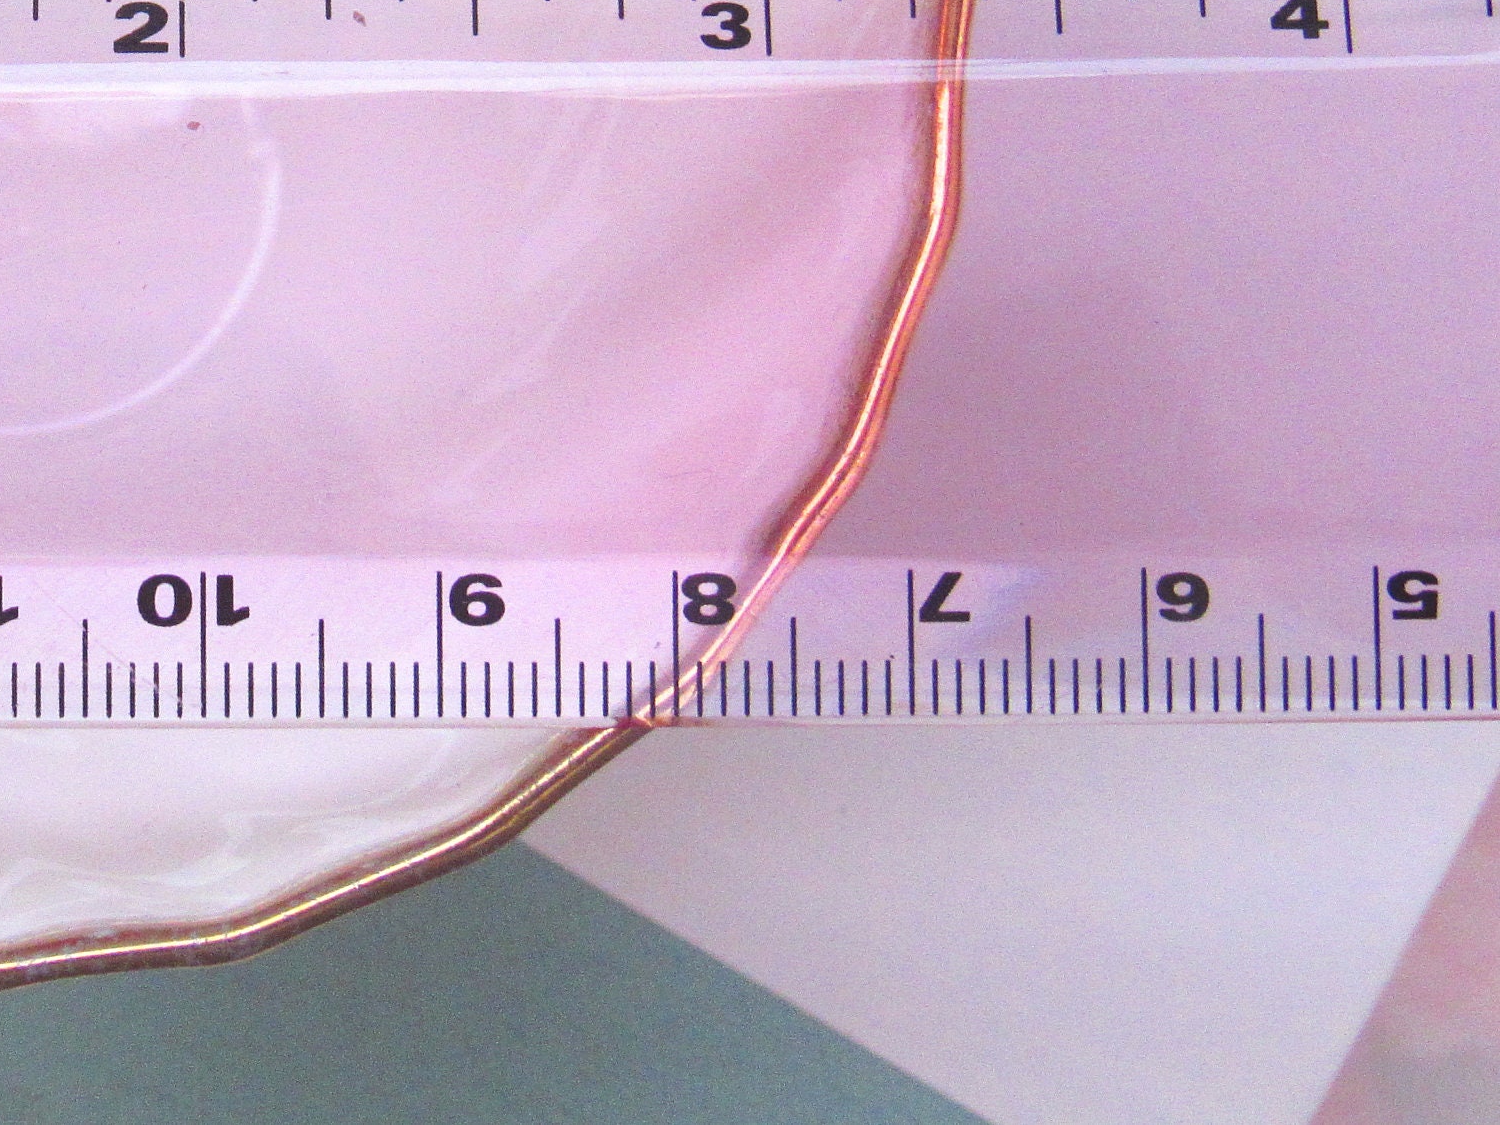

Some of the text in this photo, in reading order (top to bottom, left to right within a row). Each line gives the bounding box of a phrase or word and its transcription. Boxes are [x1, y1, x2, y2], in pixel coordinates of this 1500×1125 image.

[113, 1, 169, 54] 2
[700, 1, 752, 50] 3
[136, 574, 250, 628] 10
[448, 572, 506, 627] 9
[680, 572, 738, 626] 8
[918, 571, 971, 623] 7
[1155, 571, 1211, 623] 6
[1386, 569, 1439, 621] 5
